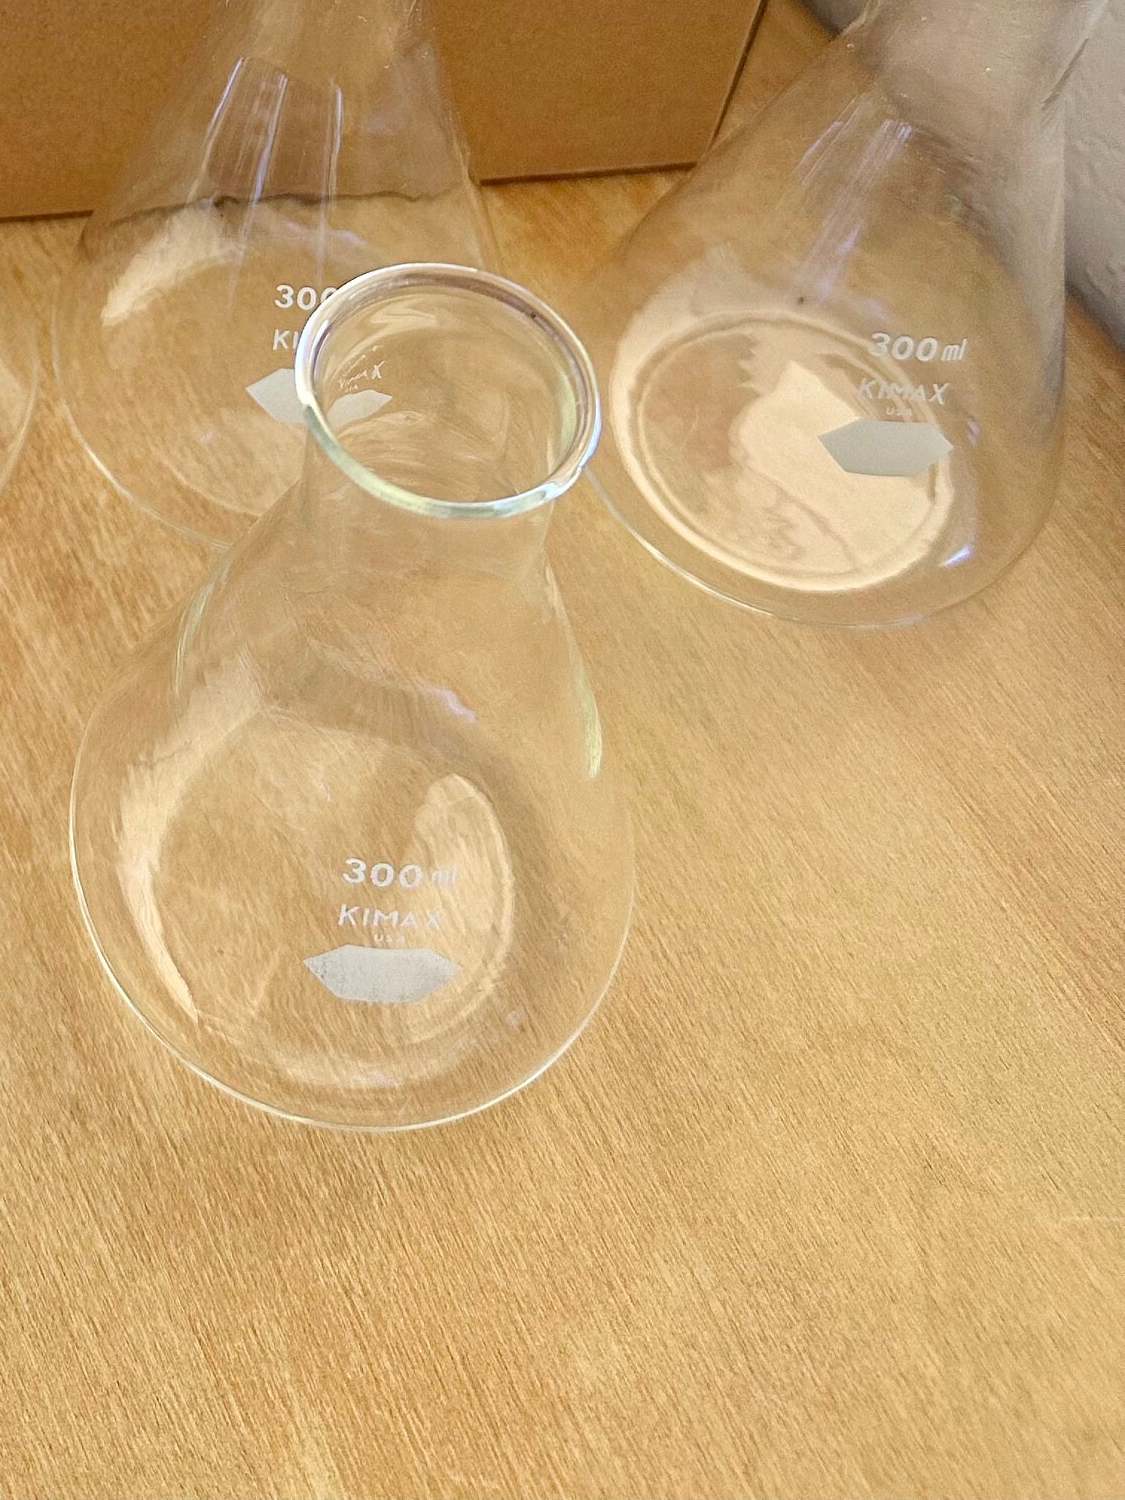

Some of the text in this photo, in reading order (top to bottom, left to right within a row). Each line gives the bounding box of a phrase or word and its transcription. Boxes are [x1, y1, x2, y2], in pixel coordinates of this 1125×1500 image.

[868, 332, 968, 362] 300 ml
[342, 858, 424, 888] 300
[338, 902, 444, 930] KIMAX
